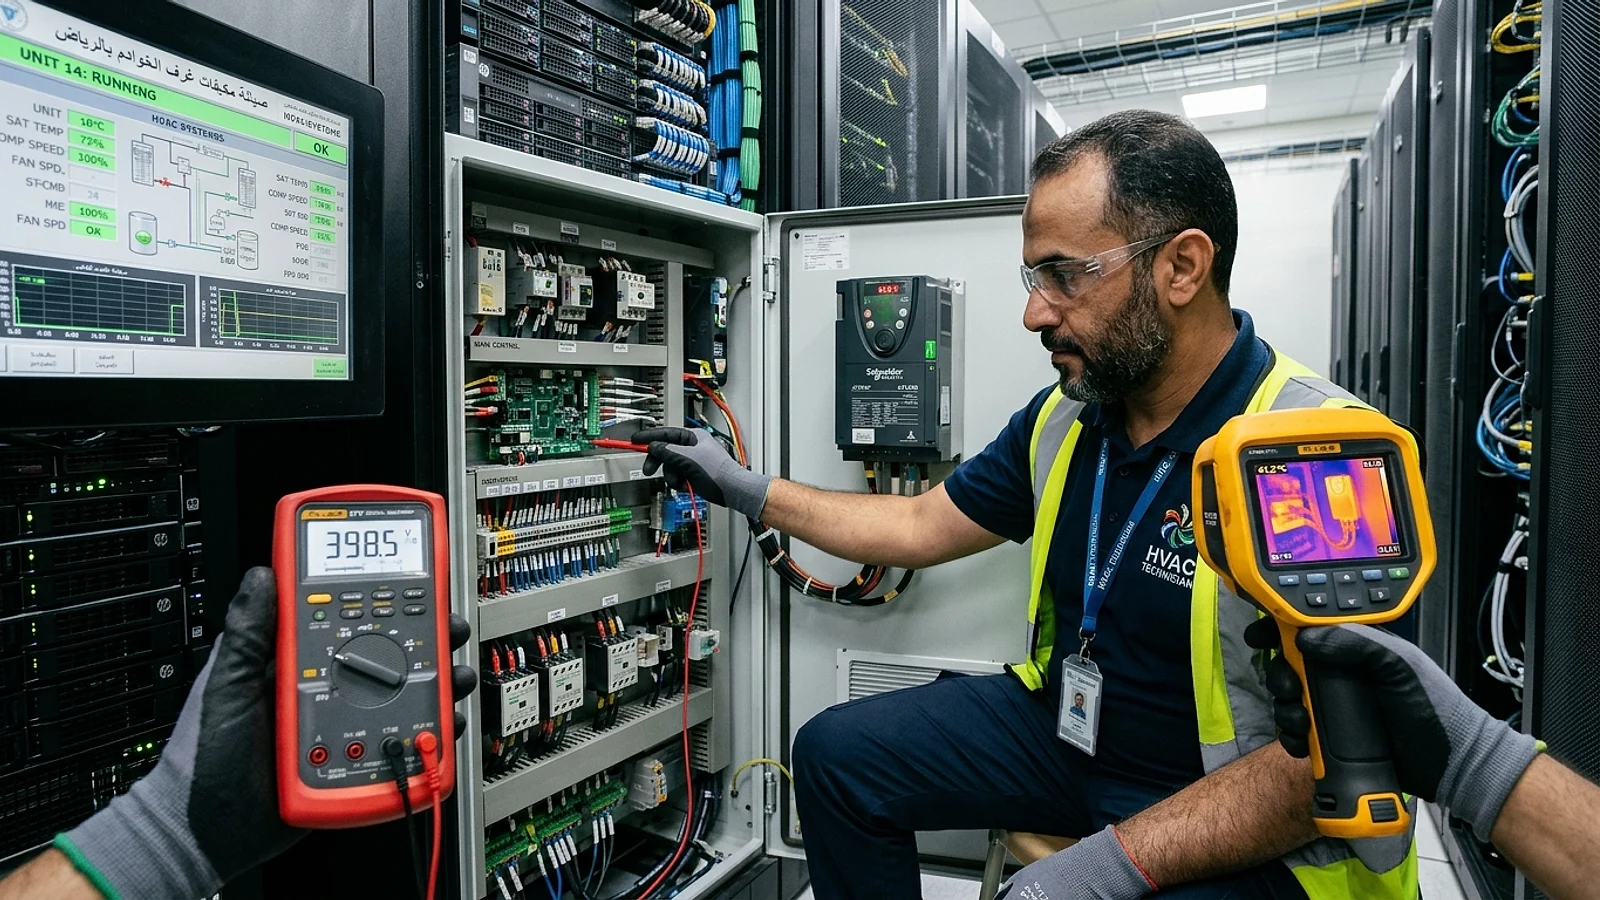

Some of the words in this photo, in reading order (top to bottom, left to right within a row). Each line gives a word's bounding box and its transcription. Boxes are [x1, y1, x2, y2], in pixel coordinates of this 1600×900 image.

[20, 46, 60, 69] UNIT
[64, 63, 88, 79] 14:
[32, 103, 62, 119] UNIT
[6, 114, 30, 128] SAT
[33, 121, 64, 137] TEMP
[28, 139, 65, 156] SPEED
[313, 142, 329, 156] OK
[11, 154, 35, 168] FAN
[16, 213, 40, 227] FAN
[43, 218, 66, 230] SPD
[86, 226, 101, 236] OK
[326, 529, 398, 559] 398.5
[405, 529, 412, 537] V
[1145, 544, 1196, 577] HVAC
